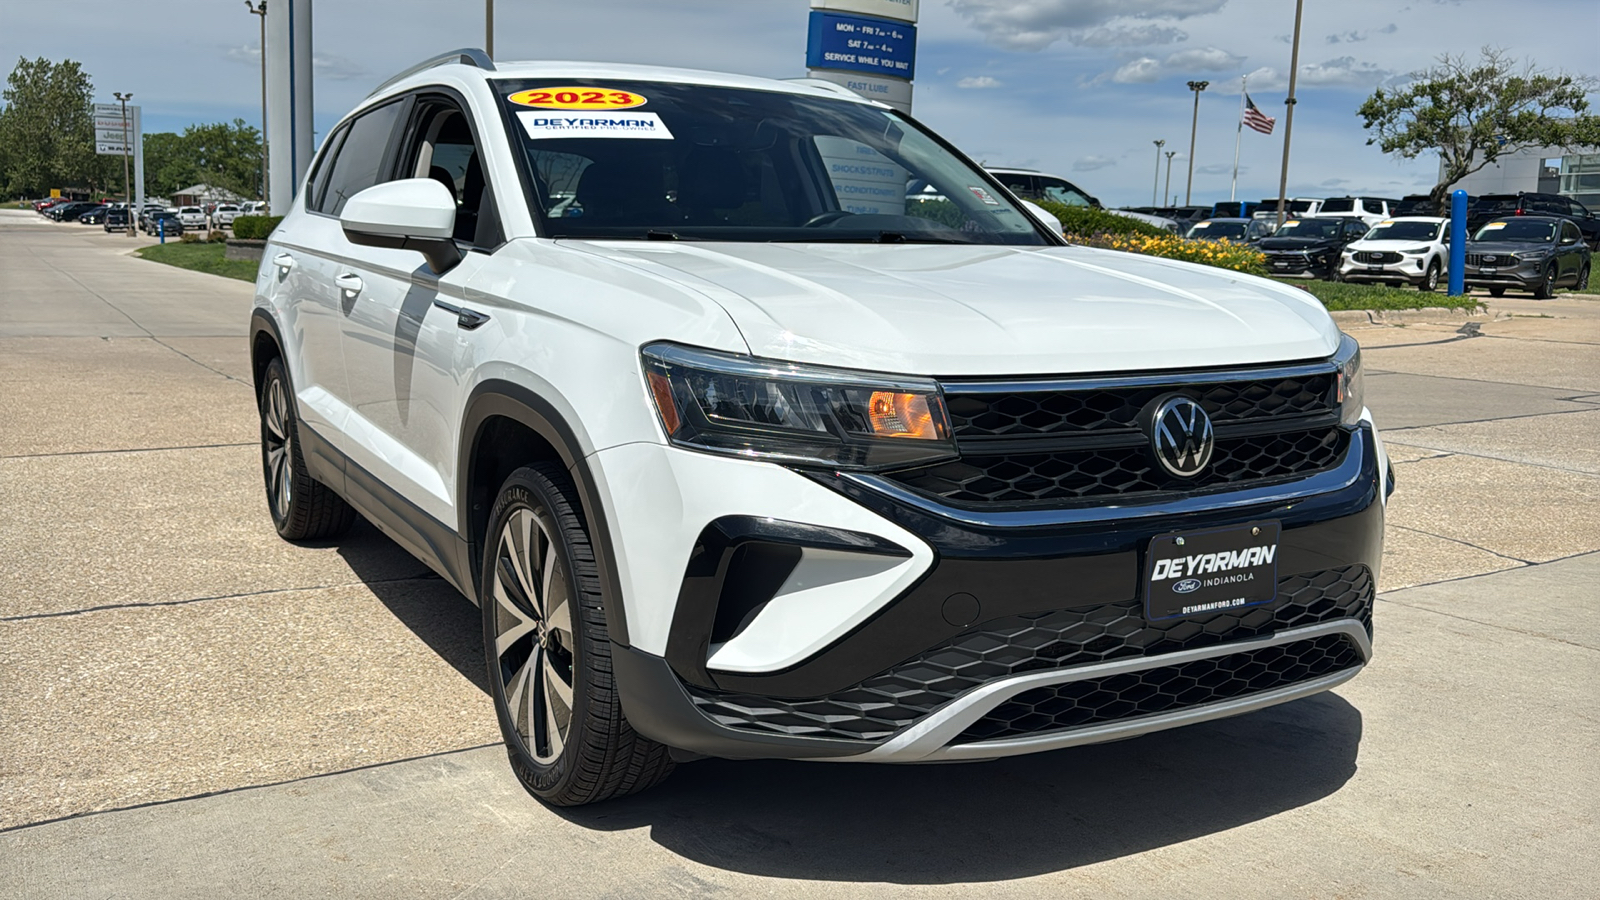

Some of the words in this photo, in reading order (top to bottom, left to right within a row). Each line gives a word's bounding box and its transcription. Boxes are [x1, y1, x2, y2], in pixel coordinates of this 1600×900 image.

[836, 23, 854, 32] MON
[862, 26, 873, 35] FRI
[847, 39, 862, 48] SAT
[824, 52, 856, 63] SERVICE
[857, 56, 879, 66] WHILE
[881, 59, 894, 68] YOU
[895, 62, 909, 70] WAIT
[847, 81, 867, 91] FAST
[869, 84, 889, 93] LUBE
[527, 91, 634, 105] 2023
[533, 118, 654, 127] DEYARMAN
[844, 185, 896, 196] CONDITIONING
[1151, 544, 1277, 581] DEYARMAN
[1176, 580, 1198, 592] Ford
[1203, 572, 1254, 587] INDIANOLA
[1182, 597, 1245, 614] DEYARMANFORD.COM
